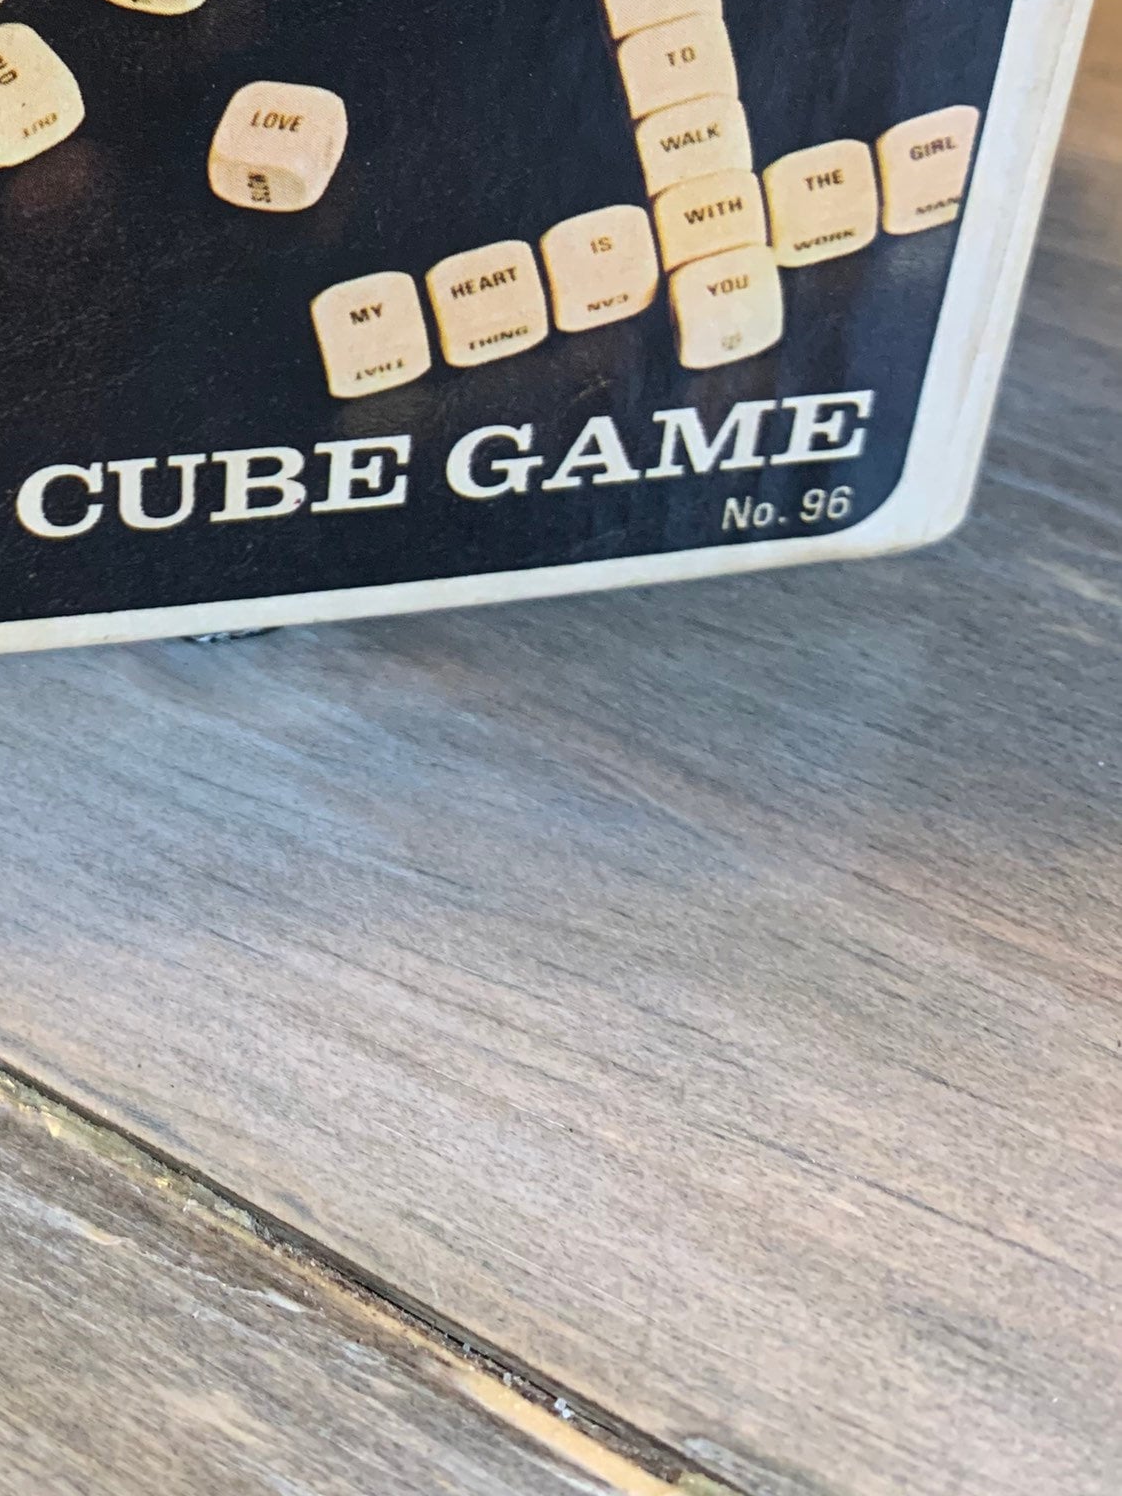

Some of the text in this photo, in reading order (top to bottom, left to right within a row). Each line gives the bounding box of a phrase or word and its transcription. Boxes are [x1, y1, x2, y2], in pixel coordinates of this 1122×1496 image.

[664, 44, 697, 67] TO
[249, 108, 304, 133] LOVE
[659, 122, 722, 153] WALK
[349, 135, 958, 325] MY HEART IS WITH THE GIRL
[792, 227, 857, 252] WORK
[706, 274, 750, 297] YOU
[468, 324, 530, 351] THING
[16, 435, 411, 538] CUBE
[445, 389, 875, 499] GAME
[721, 485, 854, 530] No. 96
